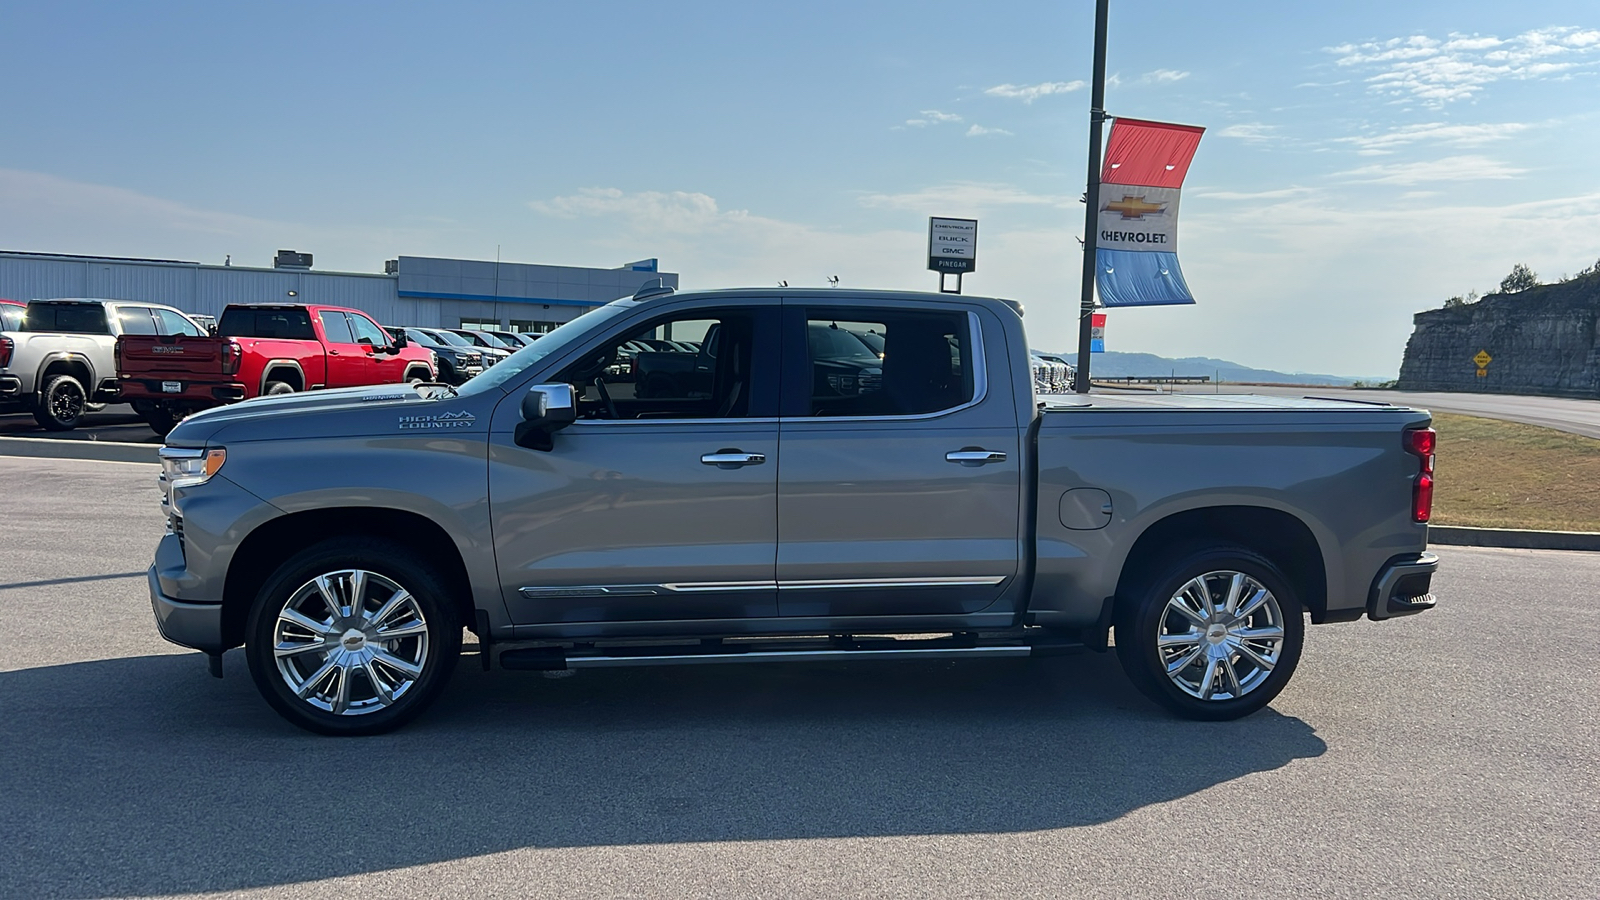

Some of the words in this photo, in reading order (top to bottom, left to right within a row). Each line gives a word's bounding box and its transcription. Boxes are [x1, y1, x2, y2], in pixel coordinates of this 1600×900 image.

[938, 235, 969, 243] BUICK
[1101, 230, 1167, 244] CHEVROLET
[938, 260, 967, 268] PINEGAR
[152, 346, 184, 354] GMC
[399, 415, 438, 423] HIGH
[399, 420, 475, 429] COUNTRY
